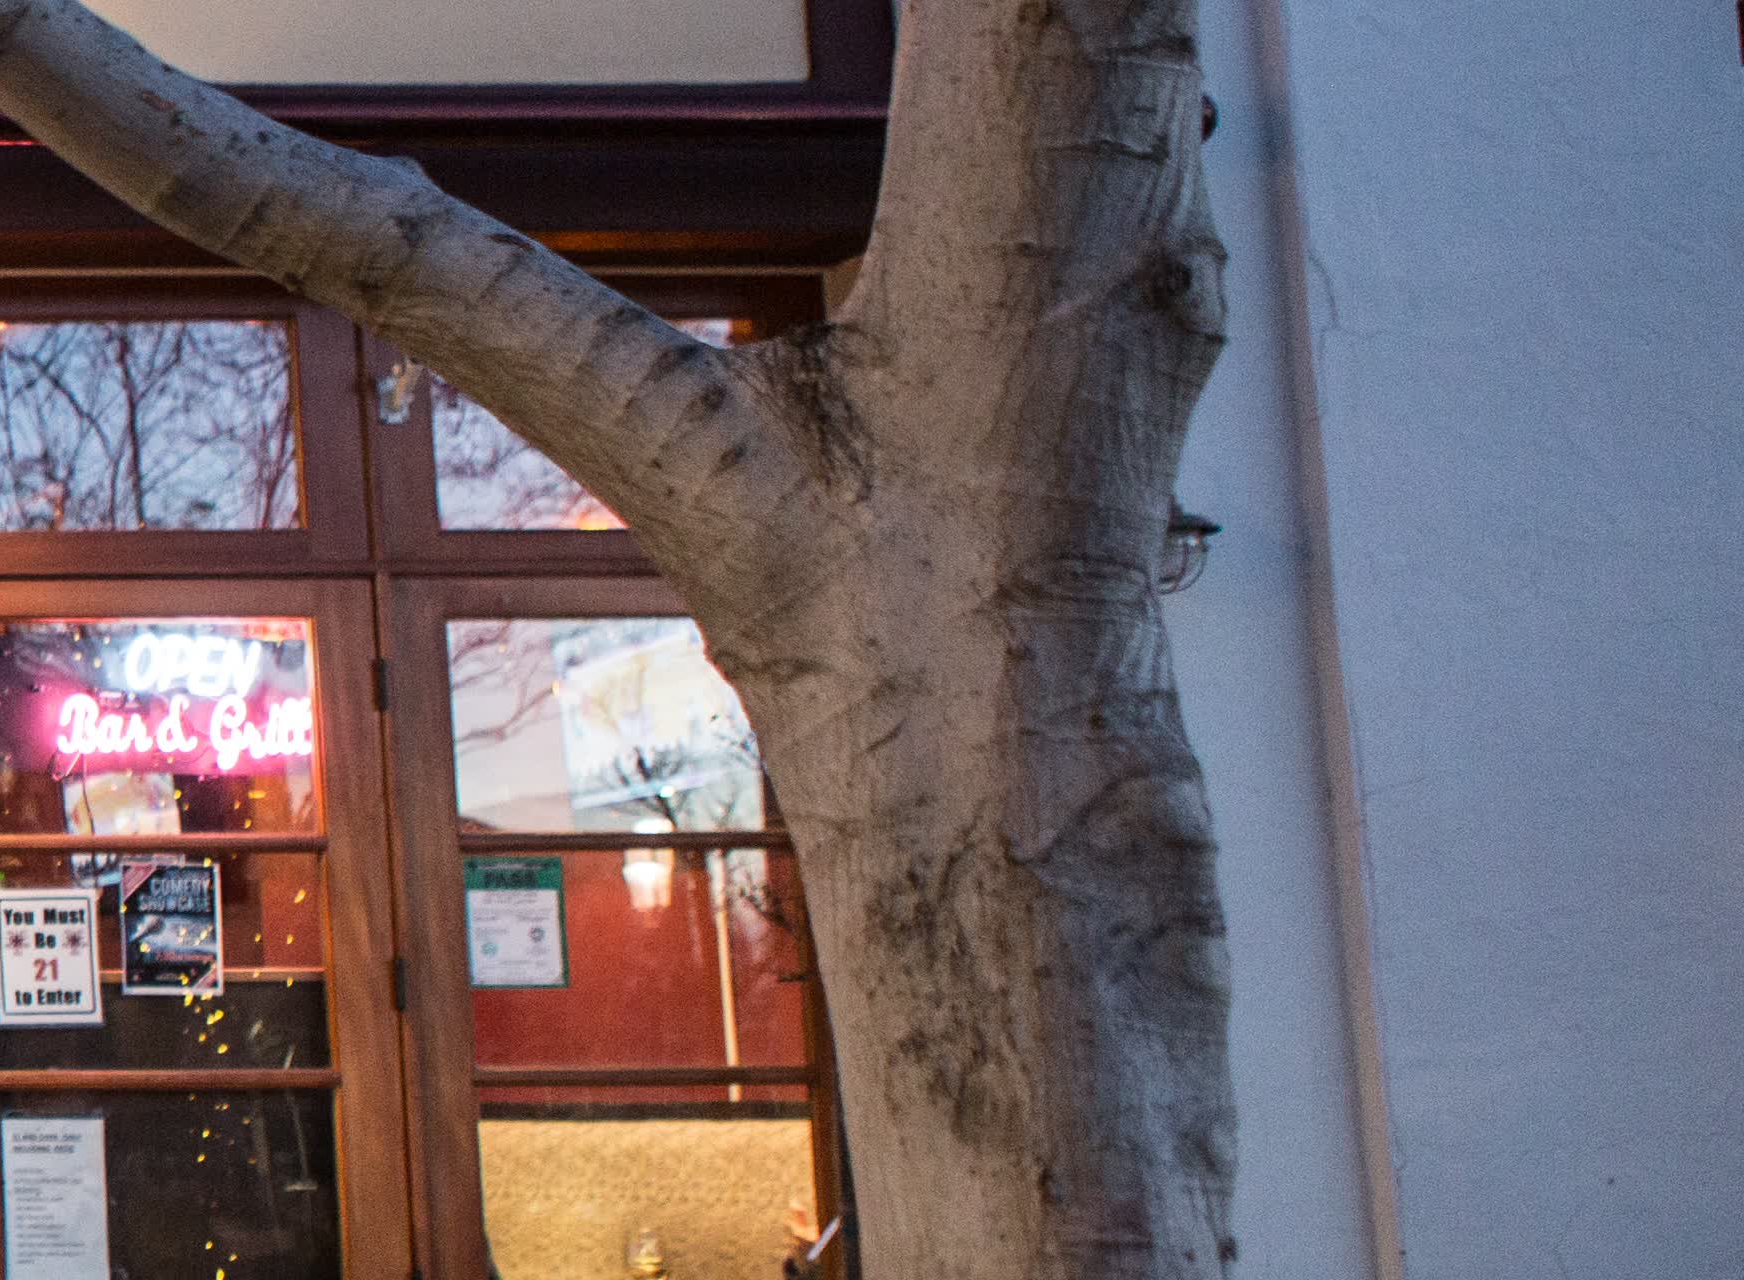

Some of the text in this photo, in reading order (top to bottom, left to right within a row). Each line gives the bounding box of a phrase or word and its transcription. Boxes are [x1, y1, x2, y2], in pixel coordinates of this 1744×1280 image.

[124, 632, 262, 698] OPEN
[56, 692, 154, 754] Bar
[3, 908, 86, 925] You Must
[34, 932, 57, 949] Be
[33, 958, 59, 981] 21
[15, 988, 82, 1005] to Enter
